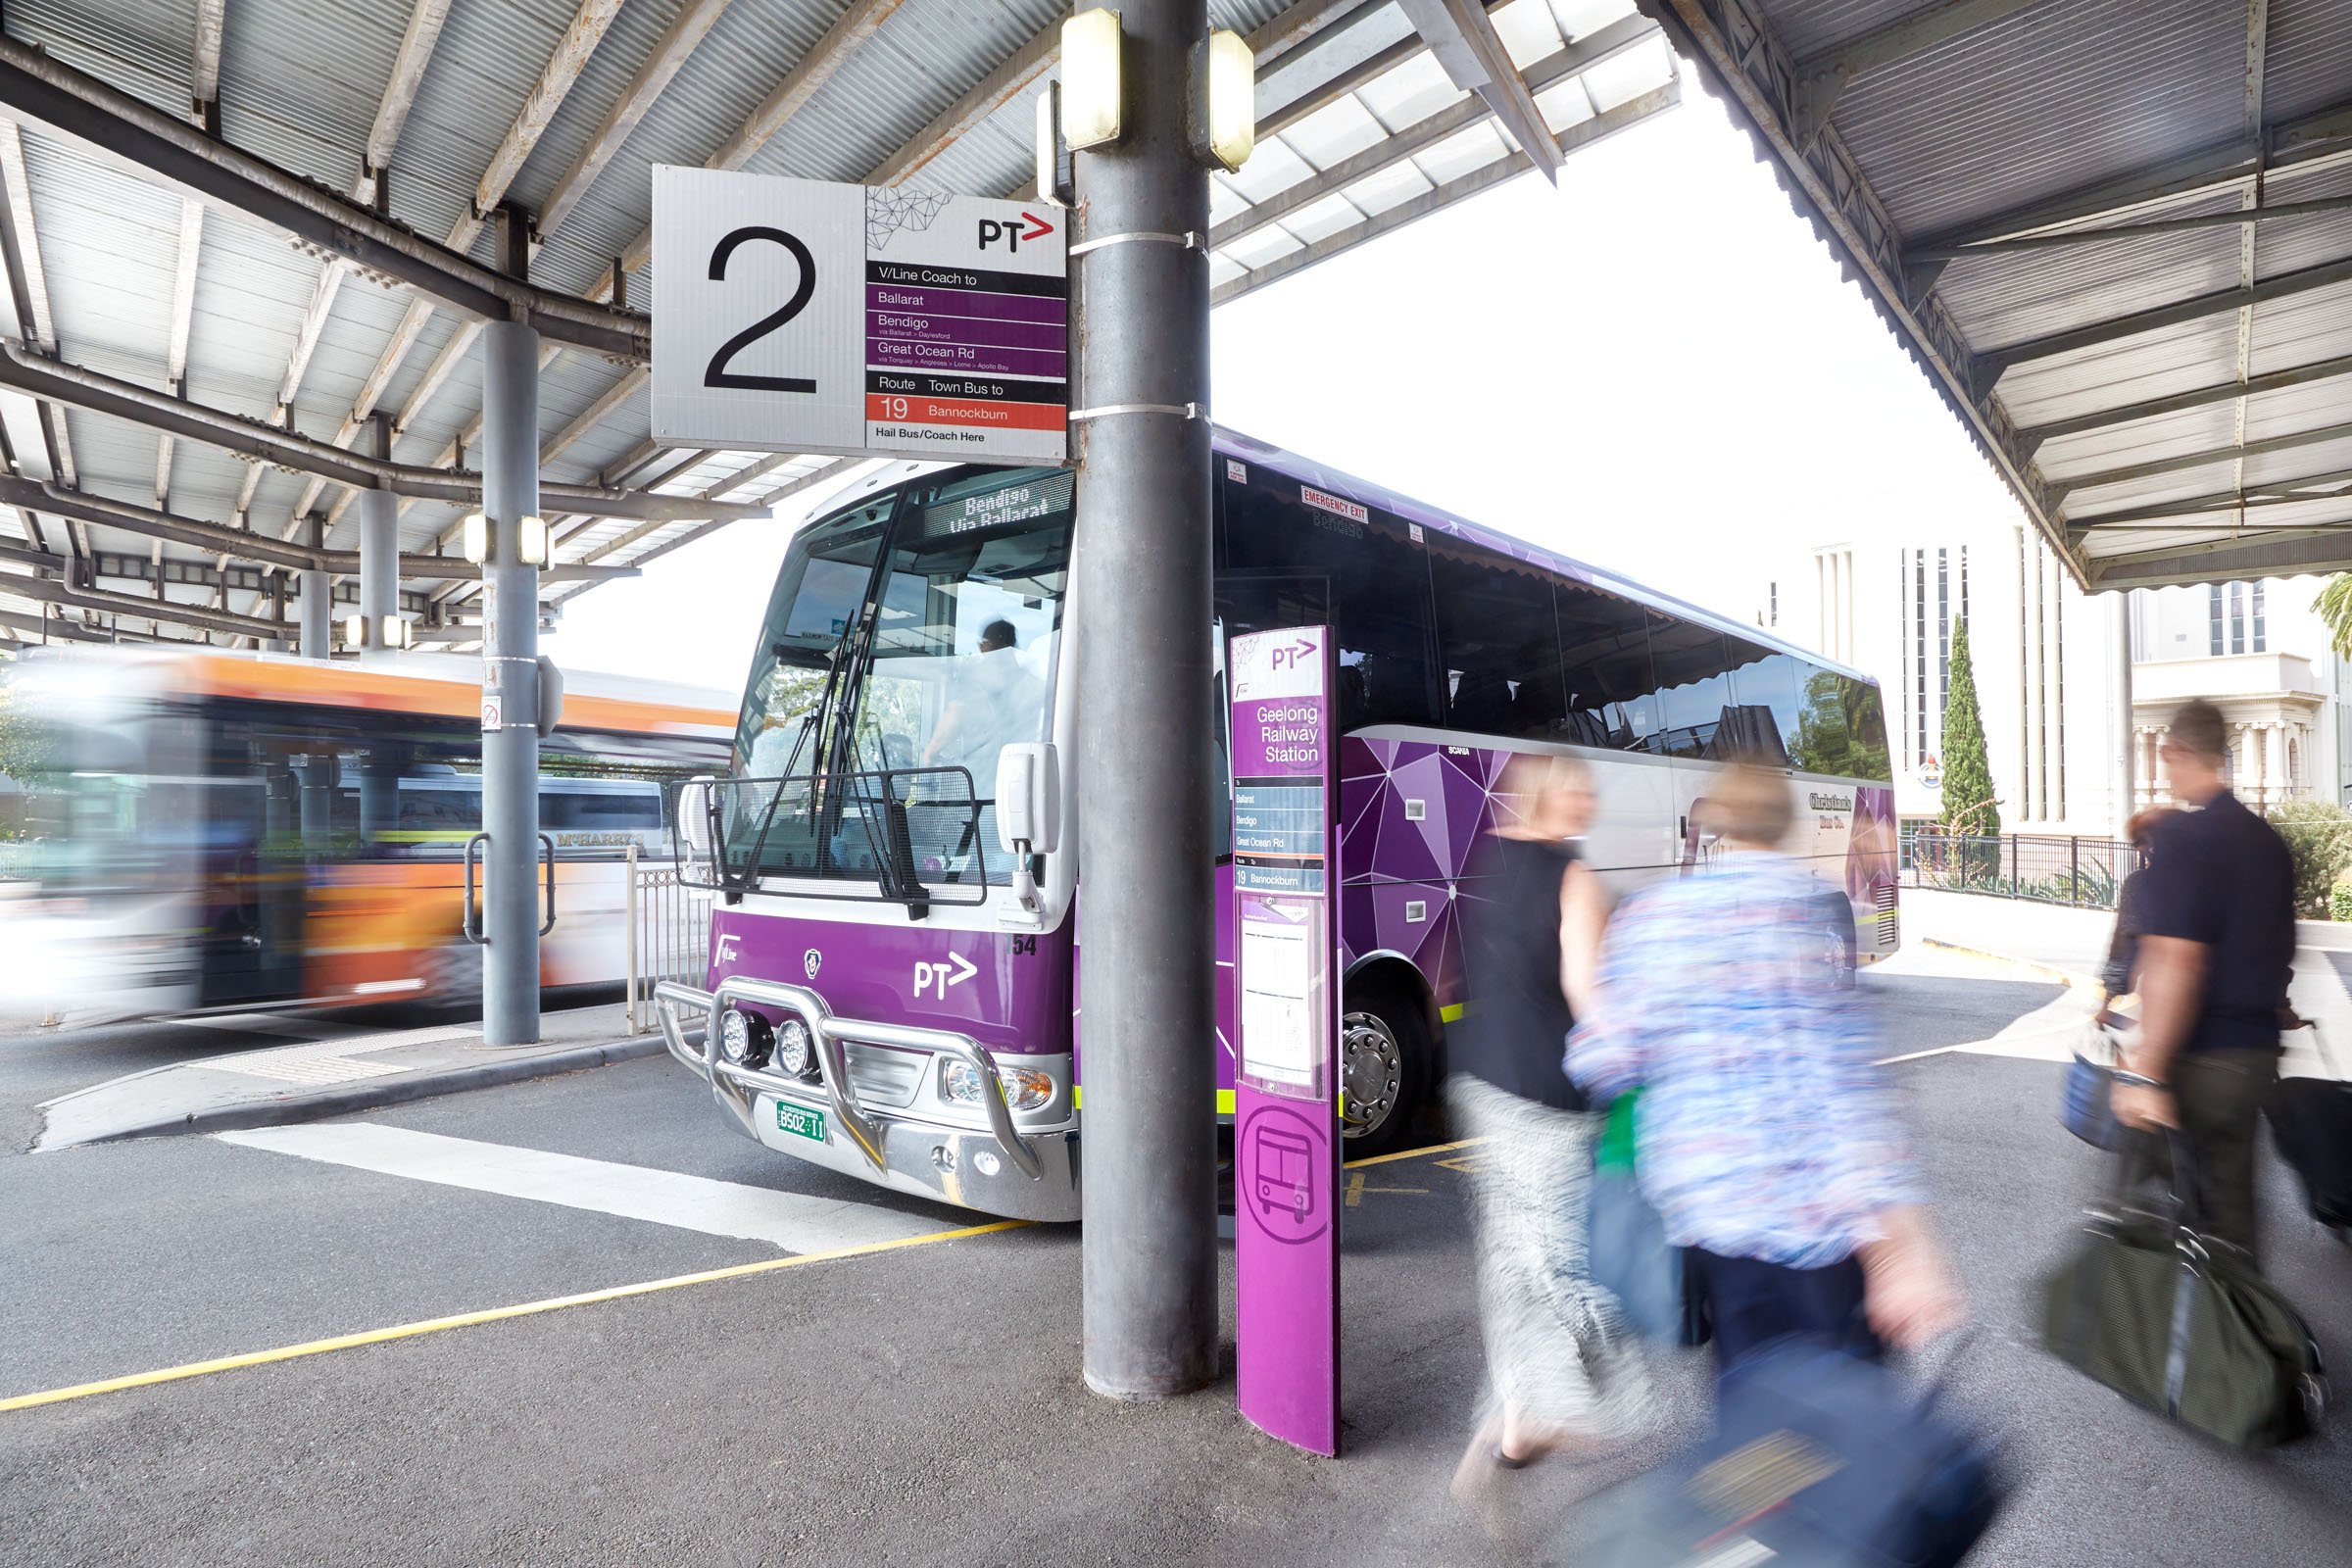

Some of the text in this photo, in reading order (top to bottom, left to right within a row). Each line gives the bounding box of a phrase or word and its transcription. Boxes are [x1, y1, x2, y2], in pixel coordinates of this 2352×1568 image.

[878, 267, 978, 286] V/Line Coach to
[878, 291, 924, 306] Ballarat
[704, 225, 816, 394] 2
[878, 315, 929, 331] Bendigo
[889, 328, 912, 337] Ballarat
[918, 331, 951, 340] Daylesford
[877, 342, 975, 360] Great Ocean Rd
[888, 356, 913, 366] Torquay
[919, 359, 948, 368] Anglesea
[879, 376, 916, 390] Route
[928, 379, 1004, 396] Town Bus to
[880, 397, 908, 419] 19
[928, 405, 1008, 420] Bannockburn
[875, 427, 985, 442] Hail Bus/Coach Here
[965, 488, 1030, 516] Bendigo
[1303, 489, 1365, 519] EMERGENCY EXIT
[1257, 706, 1318, 724] Geelong
[1261, 725, 1319, 745] Railway
[1265, 746, 1318, 762] Station
[1447, 746, 1470, 756] SCANIA
[1236, 794, 1255, 804] Ballarat
[1809, 793, 1852, 812] Christian's
[1236, 815, 1257, 827] Bendigo
[1237, 837, 1284, 848] Great Ocean Rd
[1237, 869, 1247, 885] 19
[1250, 873, 1298, 886] Bannockburn
